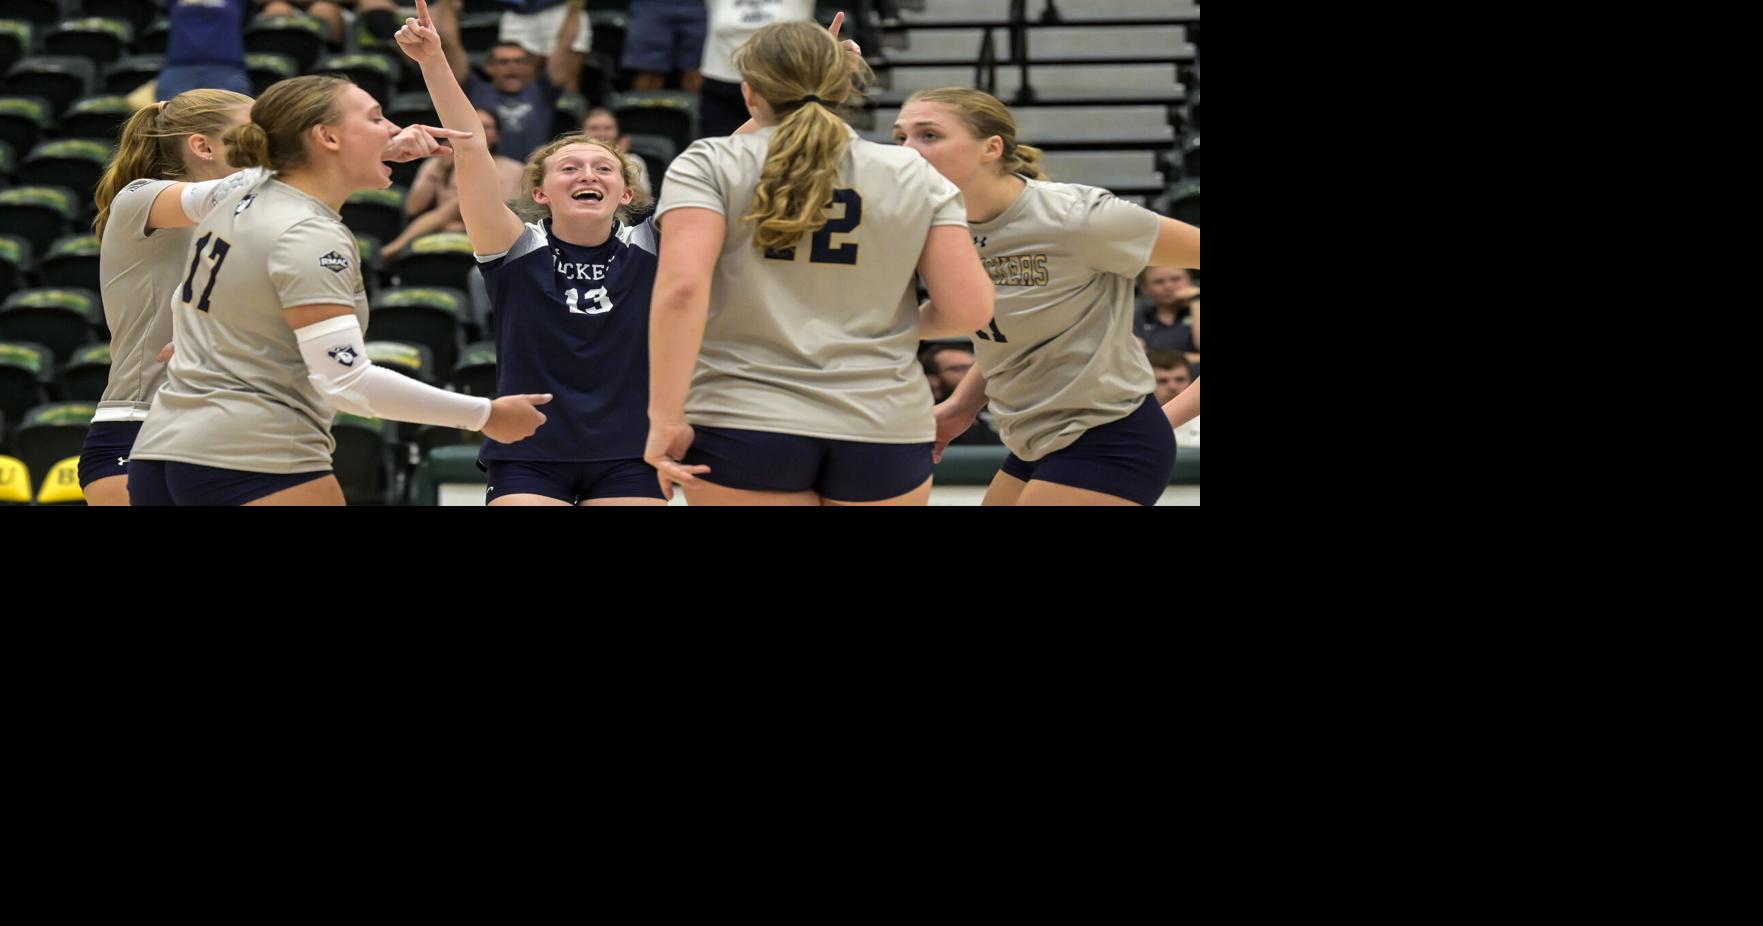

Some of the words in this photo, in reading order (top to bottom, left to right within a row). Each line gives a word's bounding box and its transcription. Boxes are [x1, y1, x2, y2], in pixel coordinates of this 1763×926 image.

[765, 188, 862, 265] 2
[182, 231, 231, 313] 17
[320, 256, 348, 267] RMAC
[565, 286, 613, 314] 13
